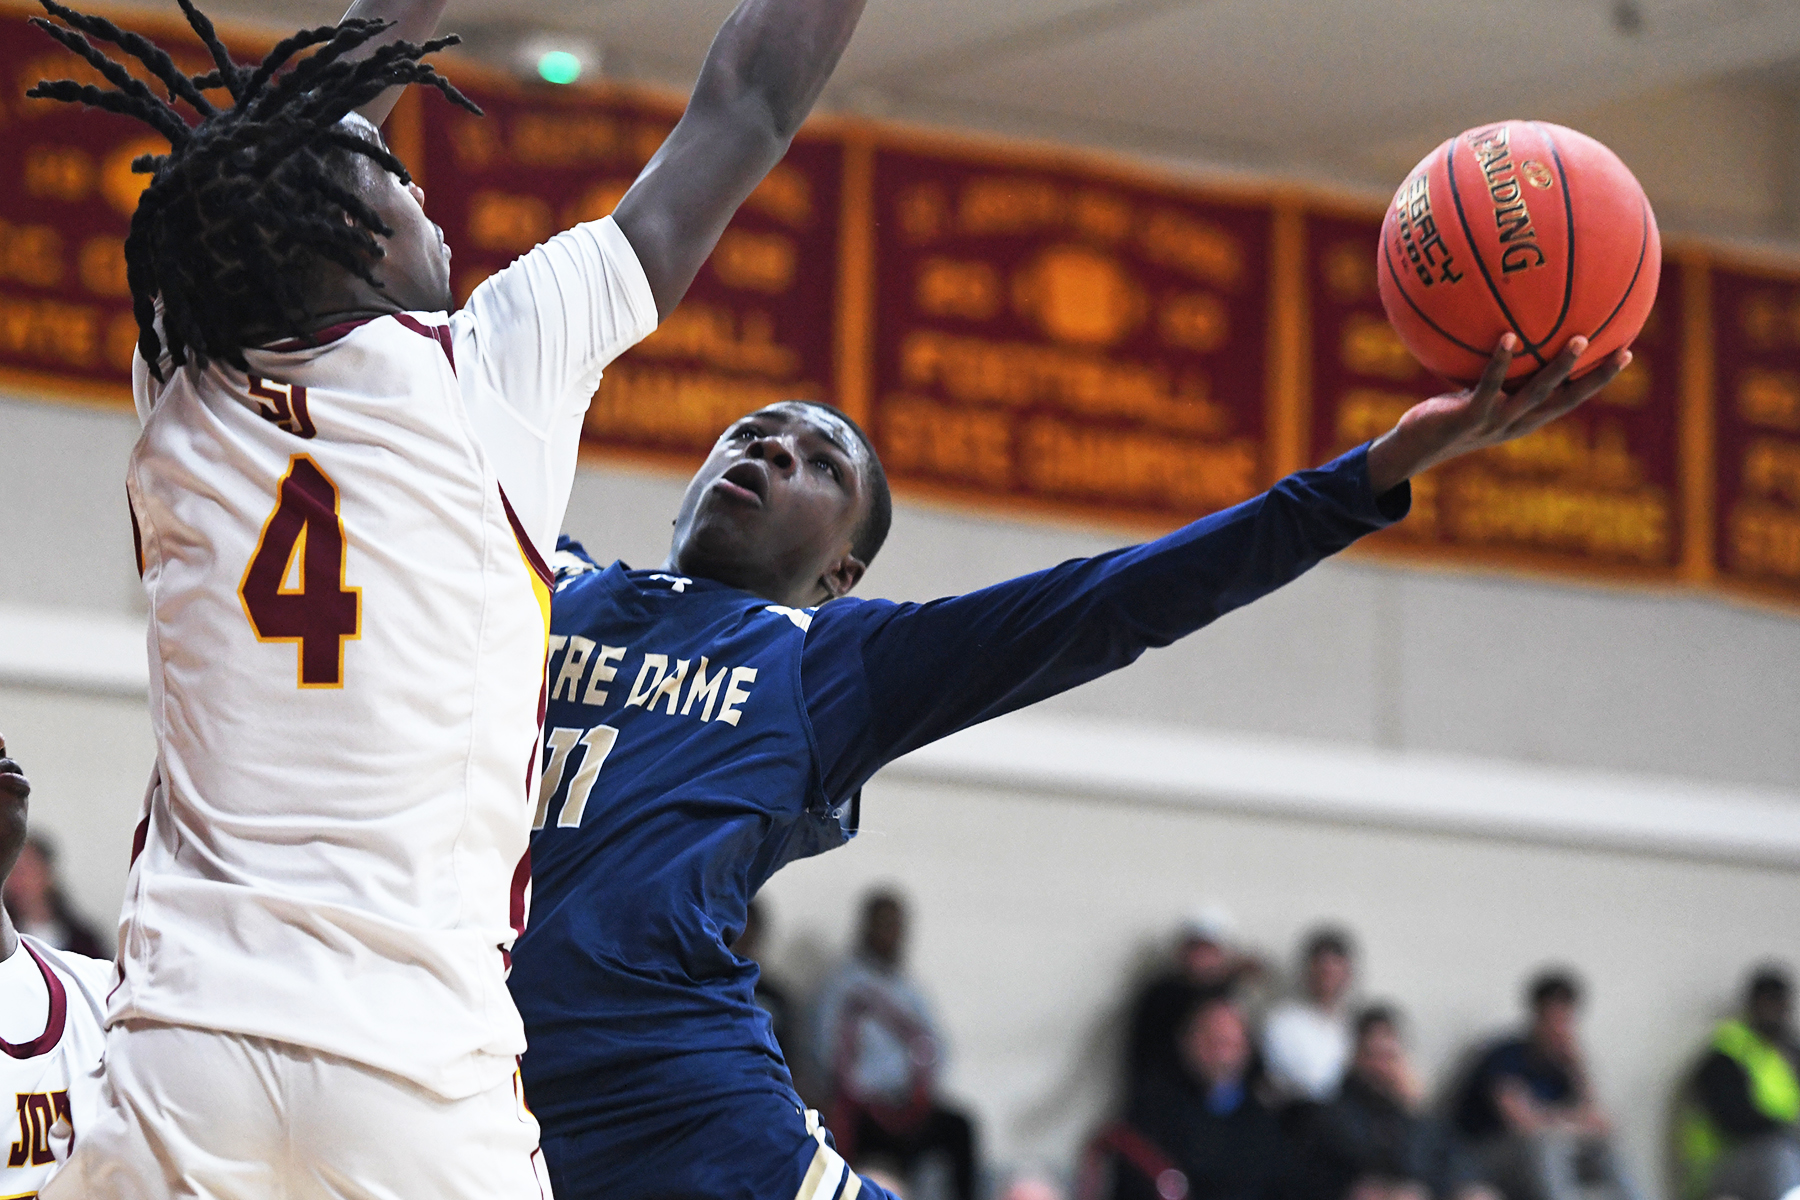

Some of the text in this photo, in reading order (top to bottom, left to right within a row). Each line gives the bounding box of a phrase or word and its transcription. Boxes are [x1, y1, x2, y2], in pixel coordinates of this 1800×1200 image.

[1409, 173, 1464, 284] EGACY
[237, 452, 362, 689] 4
[624, 653, 758, 727] DAME
[531, 724, 619, 831] 11
